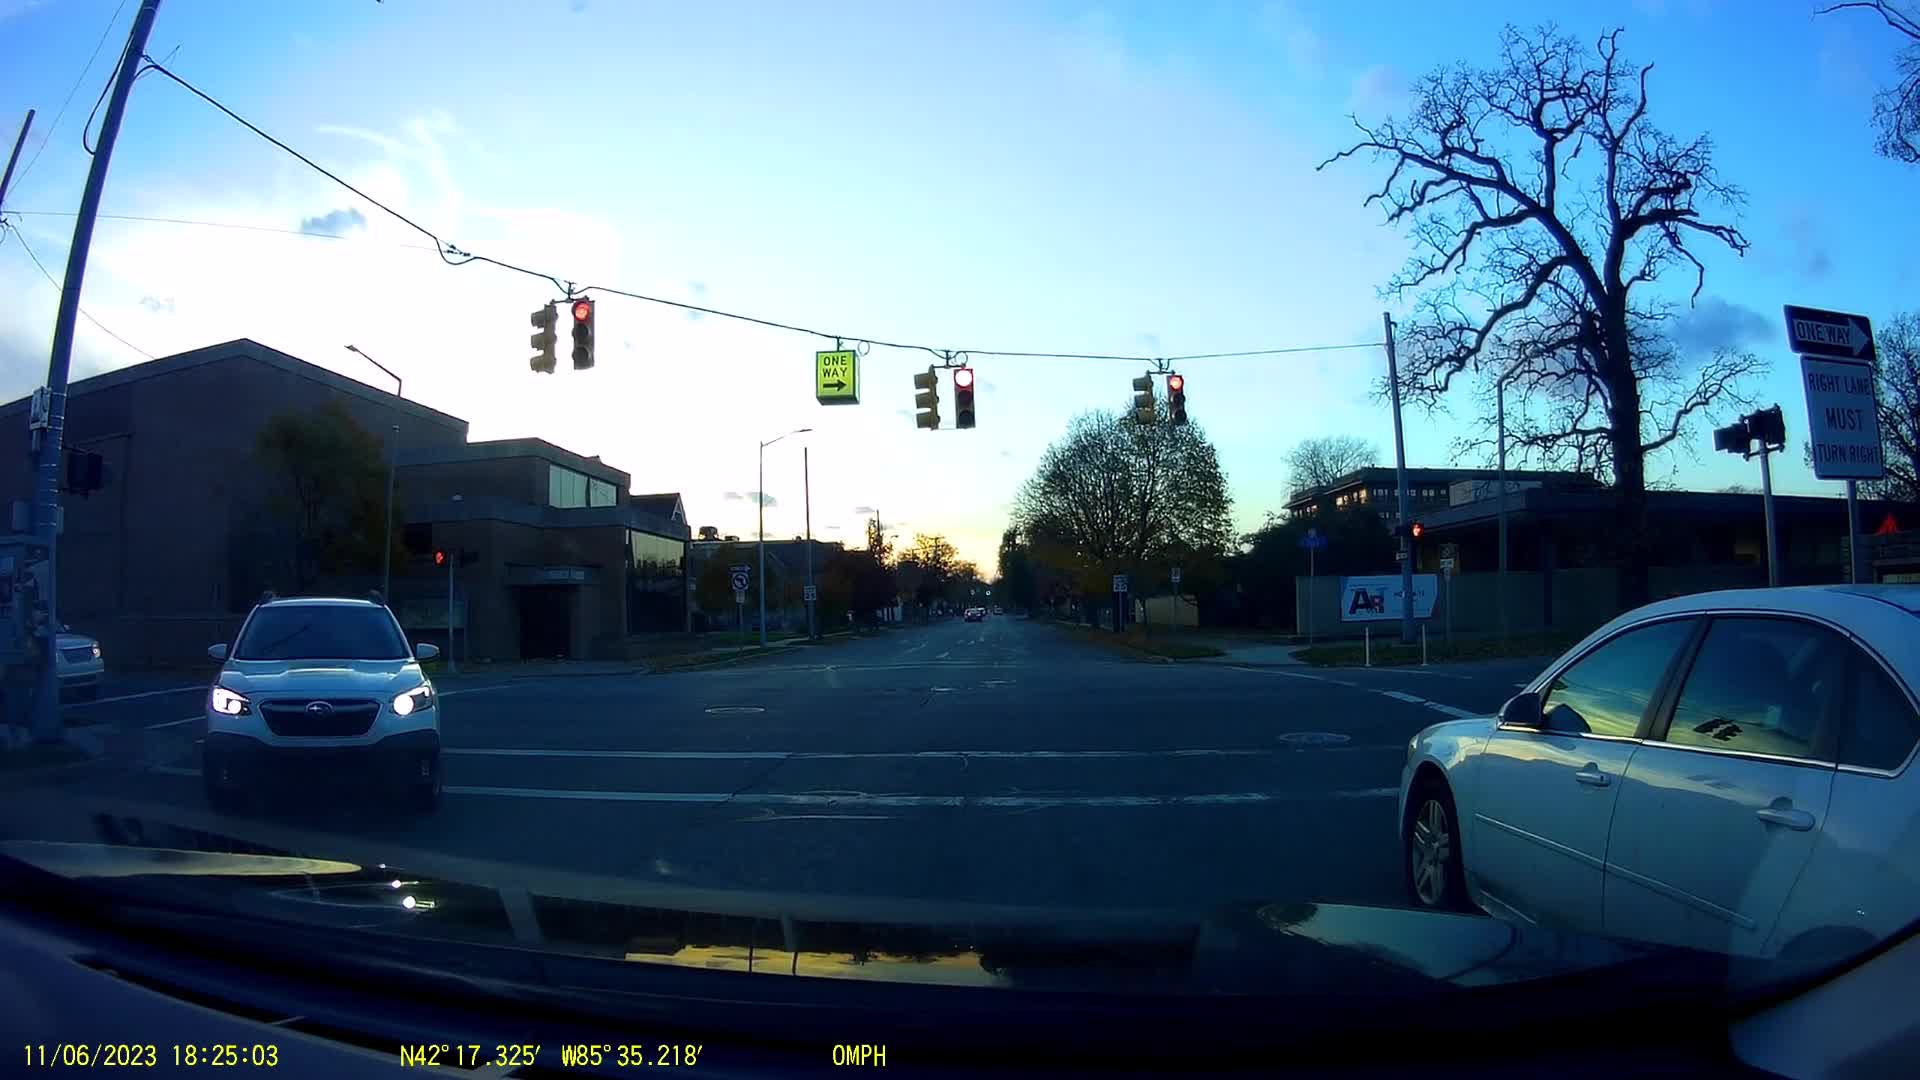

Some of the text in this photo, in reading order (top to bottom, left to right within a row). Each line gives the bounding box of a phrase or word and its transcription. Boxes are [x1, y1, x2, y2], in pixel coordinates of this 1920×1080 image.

[1796, 321, 1851, 345] ONE WAY
[823, 355, 847, 366] ONE
[822, 367, 847, 378] WAY
[1808, 373, 1870, 395] RIGHT LANE
[1825, 407, 1864, 430] MUST
[1816, 443, 1879, 464] TURN RIGHT
